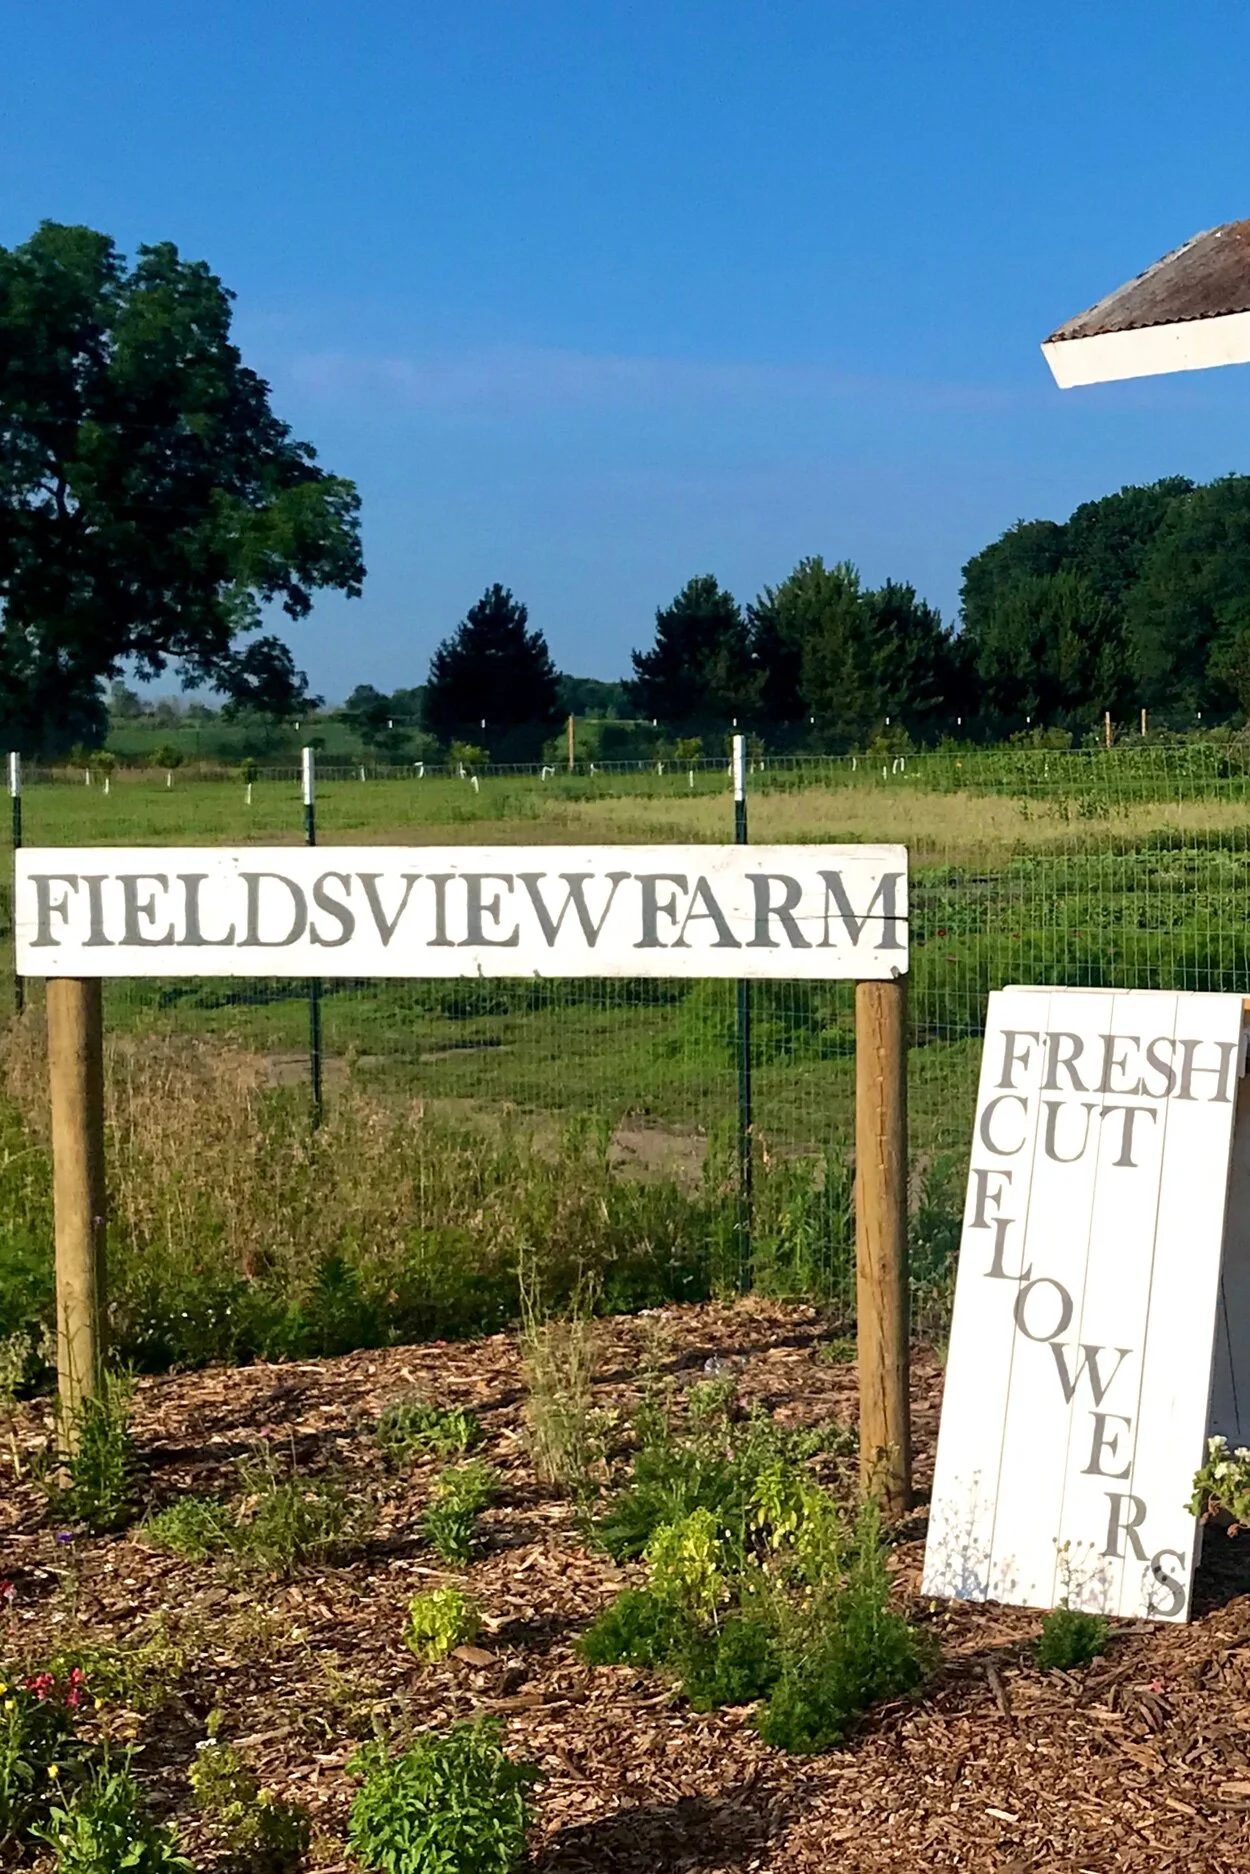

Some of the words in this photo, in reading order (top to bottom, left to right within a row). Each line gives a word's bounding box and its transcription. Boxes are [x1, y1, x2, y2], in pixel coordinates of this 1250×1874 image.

[994, 1029, 1238, 1104] FRESH
[979, 1093, 1158, 1168] CUT
[968, 1168, 1187, 1618] FLOWERS
